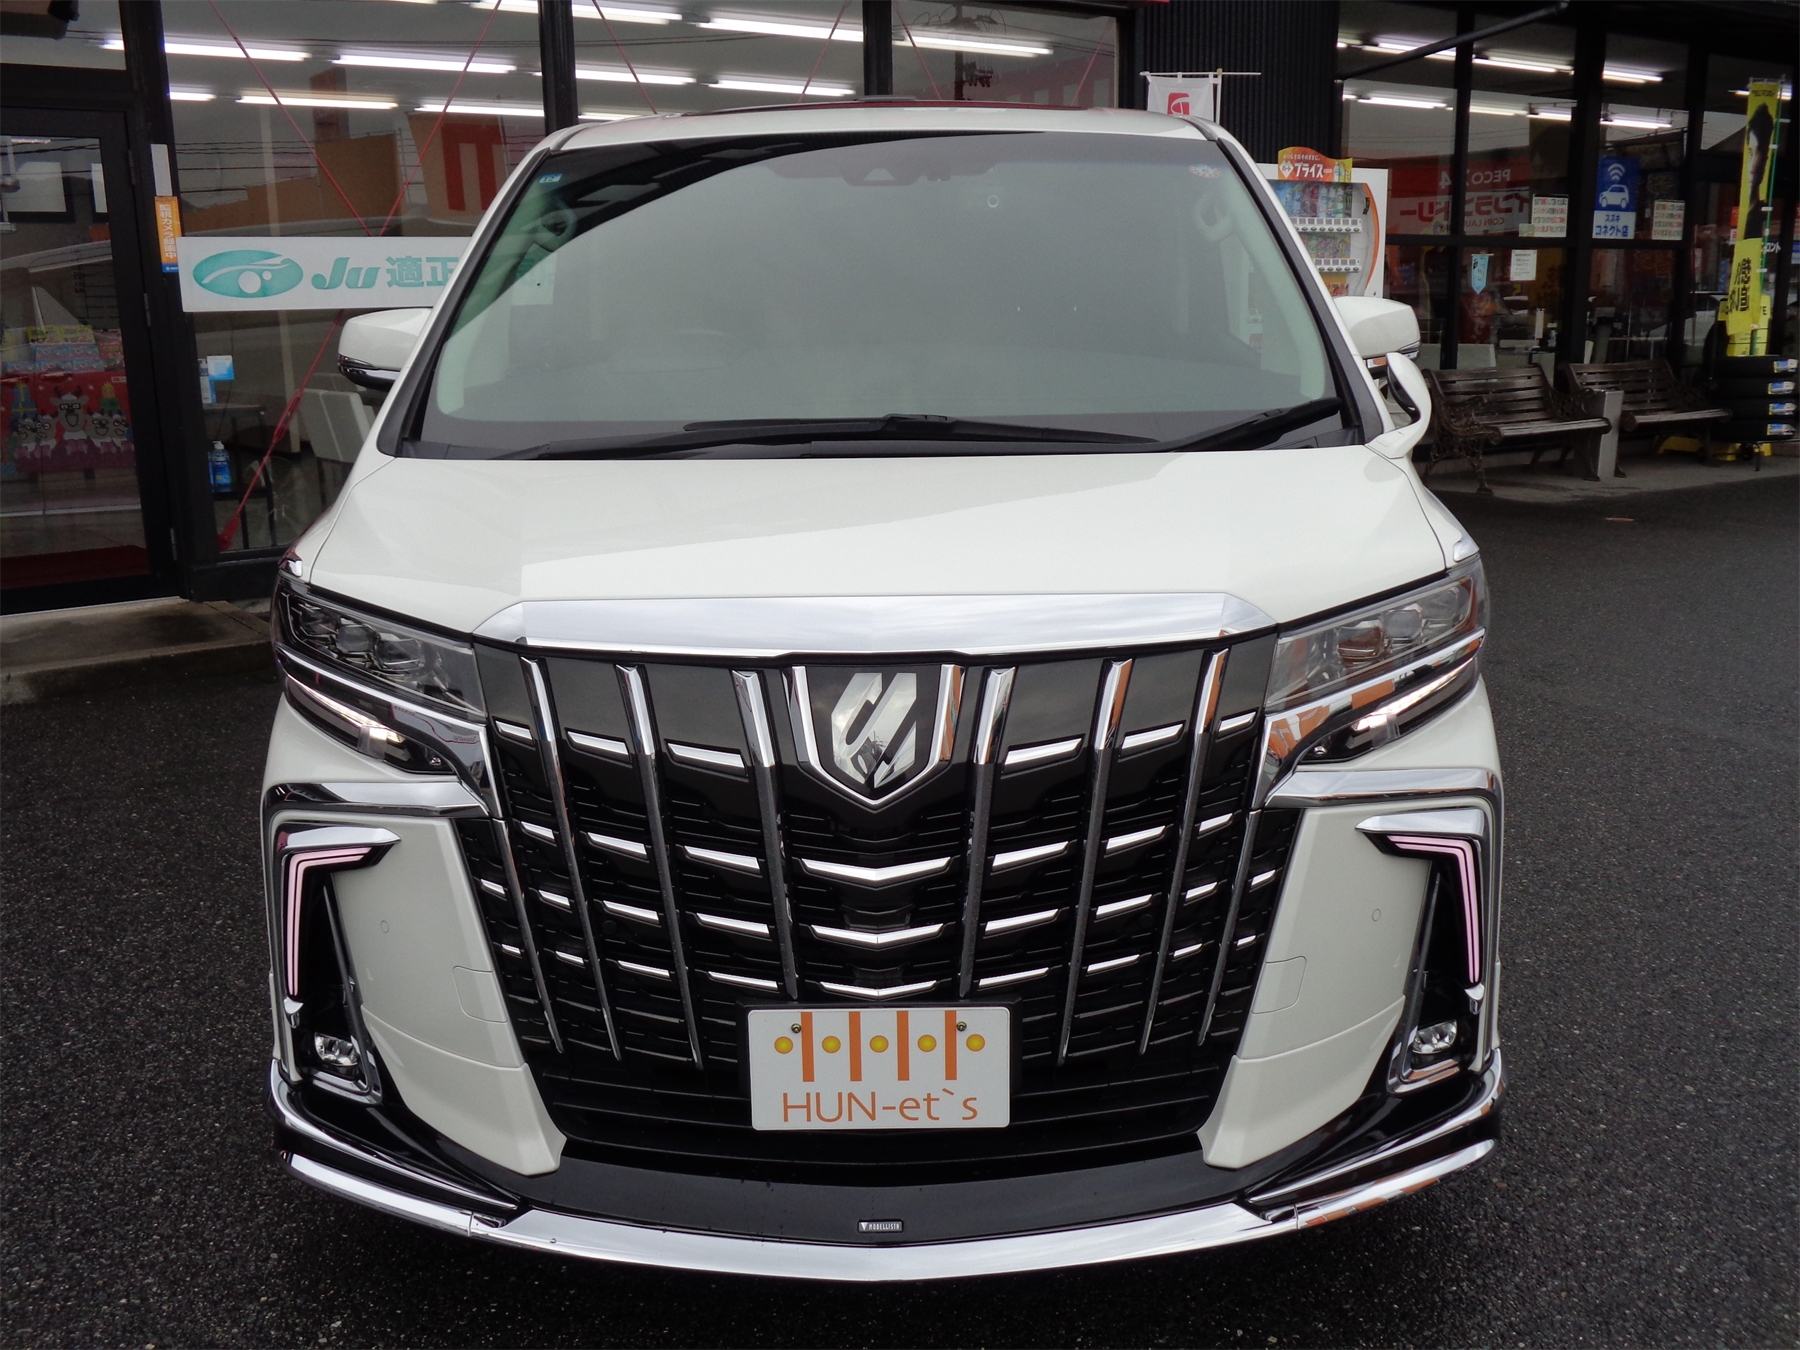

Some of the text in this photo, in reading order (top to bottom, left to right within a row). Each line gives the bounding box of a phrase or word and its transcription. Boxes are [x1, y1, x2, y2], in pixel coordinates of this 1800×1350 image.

[1605, 214, 1621, 222] スズキ
[1595, 225, 1629, 237] コネクト店
